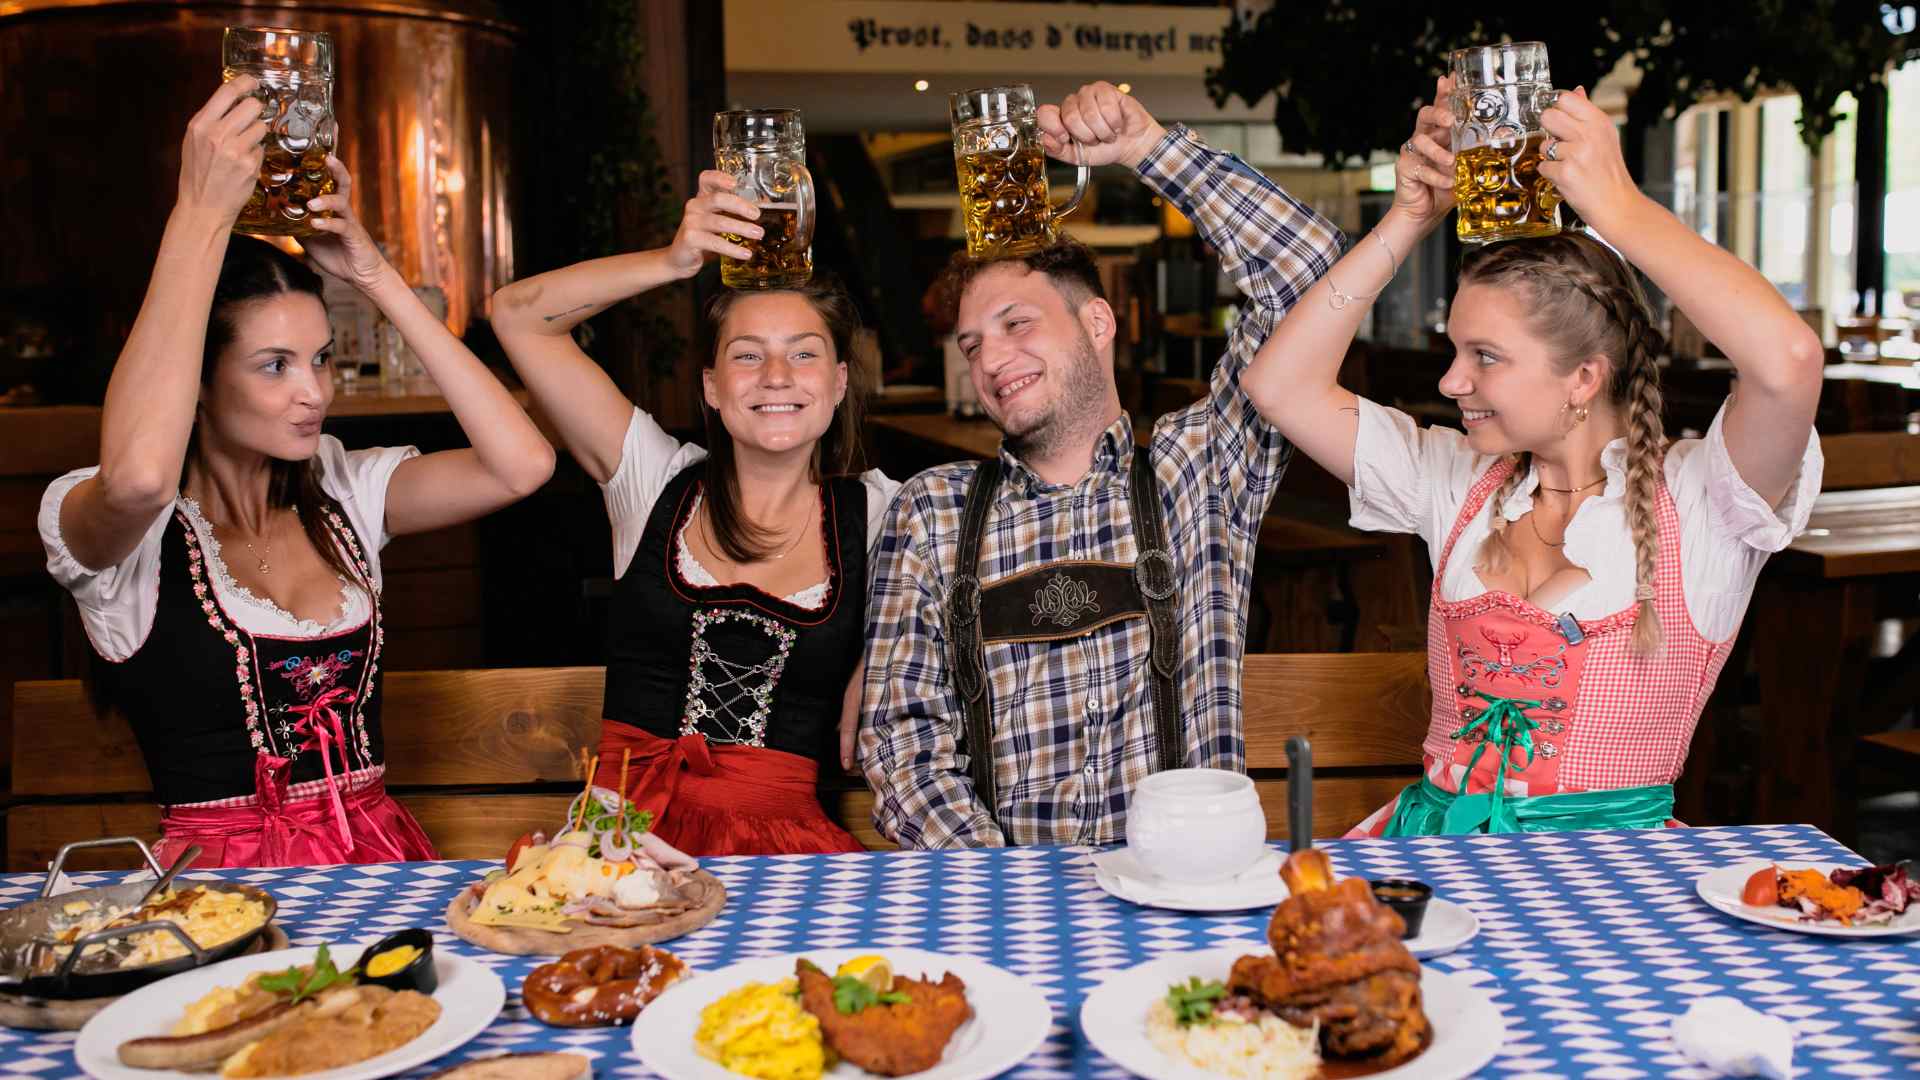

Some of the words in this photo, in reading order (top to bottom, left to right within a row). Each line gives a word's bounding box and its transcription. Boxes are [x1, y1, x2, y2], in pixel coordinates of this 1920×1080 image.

[847, 17, 951, 53] Prost,
[965, 21, 1035, 50] dass
[1188, 31, 1229, 52] ne
